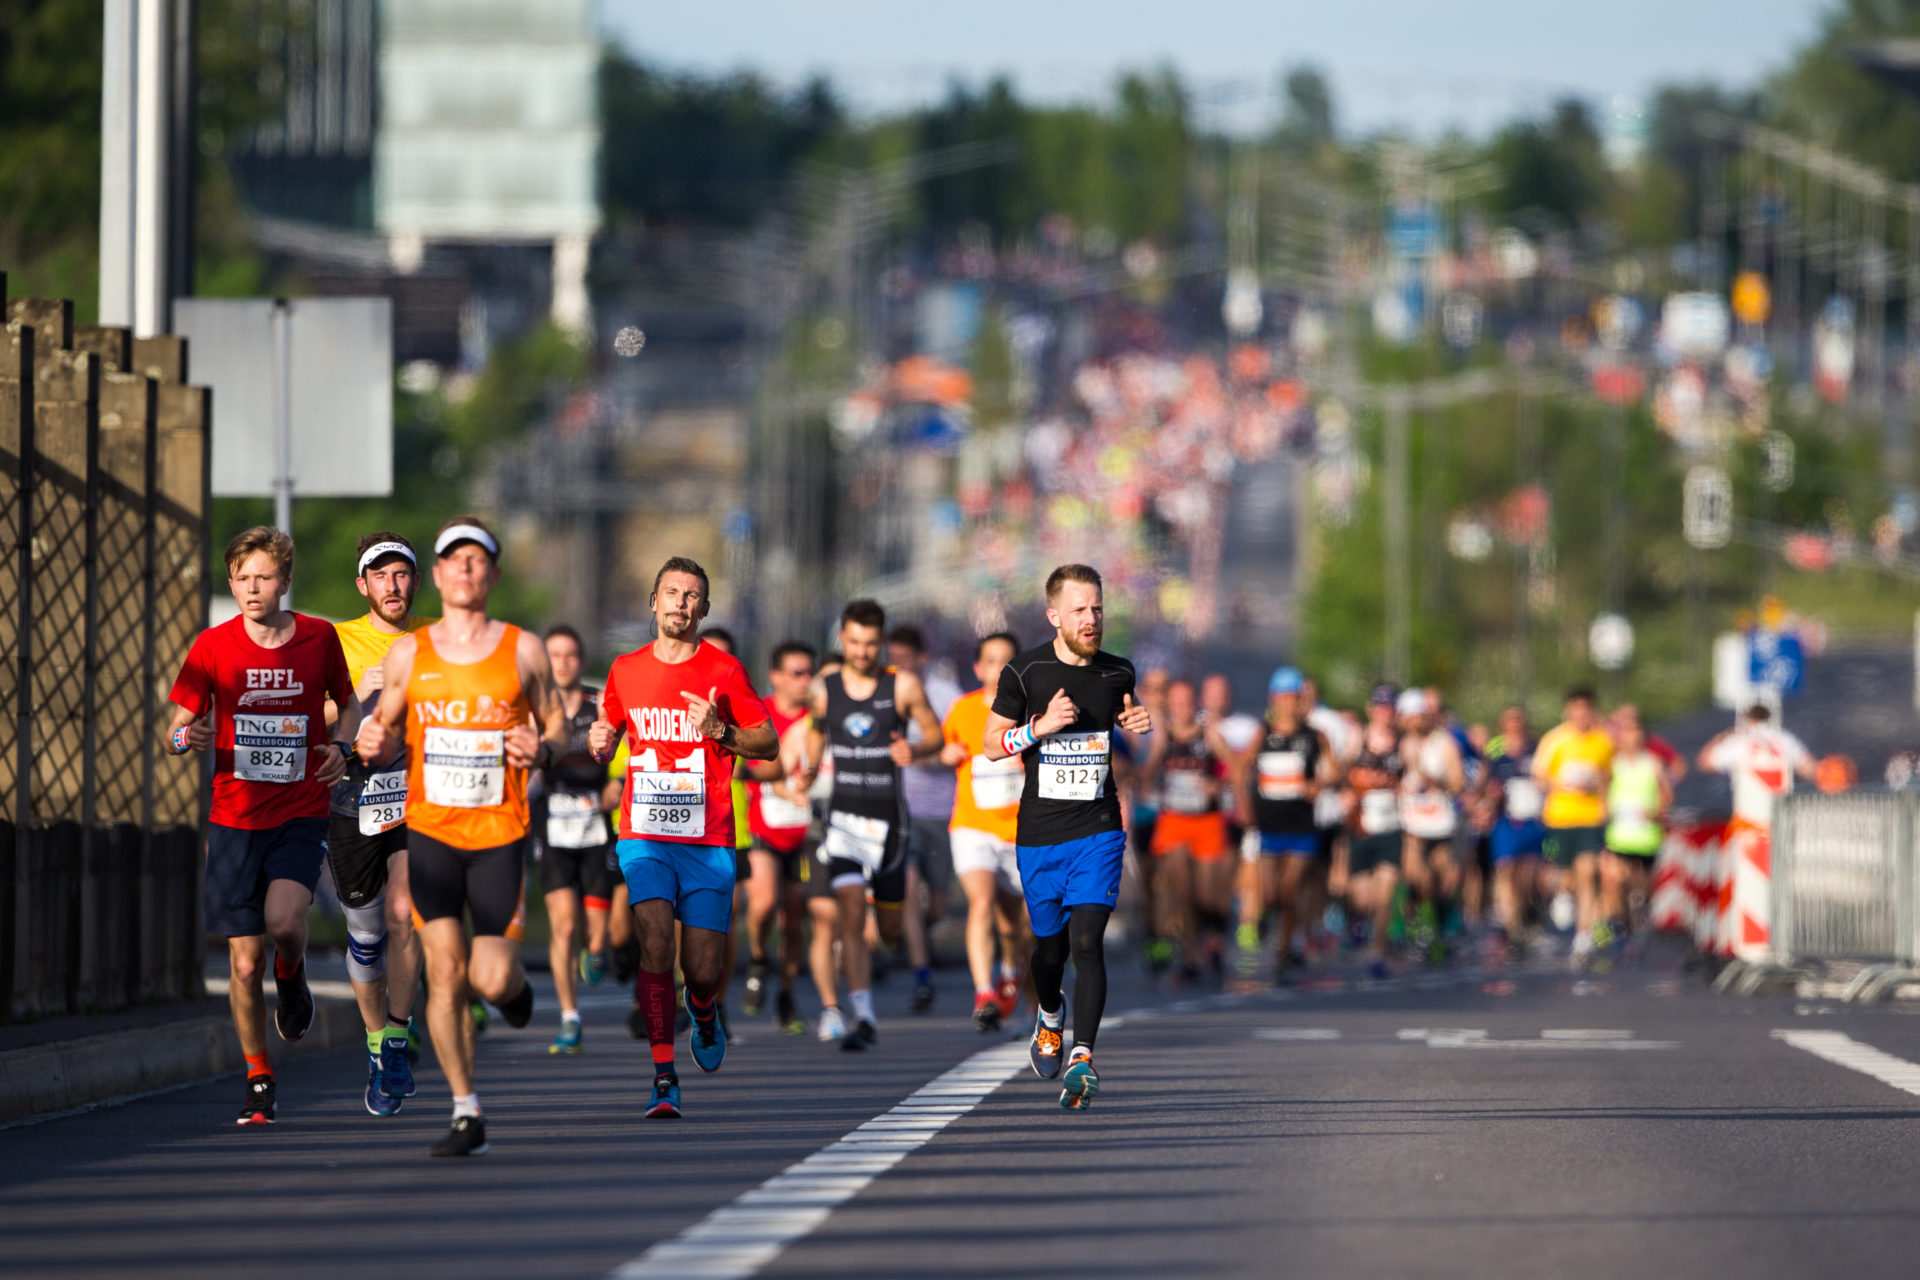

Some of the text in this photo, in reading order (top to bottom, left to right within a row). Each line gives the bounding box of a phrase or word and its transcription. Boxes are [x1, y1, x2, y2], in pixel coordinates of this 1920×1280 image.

[246, 669, 297, 688] EPFL
[414, 700, 467, 724] ING
[239, 719, 276, 734] ING
[238, 736, 303, 747] LUXEMBOURG
[430, 735, 469, 752] ING
[1046, 738, 1082, 752] ING
[250, 750, 296, 767] 8824
[1044, 756, 1105, 765] LUXEMBOURG
[365, 776, 400, 792] ING
[441, 770, 489, 789] 7034
[1056, 769, 1100, 784] 8124
[640, 778, 671, 791] ING
[637, 796, 697, 804] LUXEMBOURG
[372, 806, 403, 824] 281
[648, 809, 690, 823] 5989
